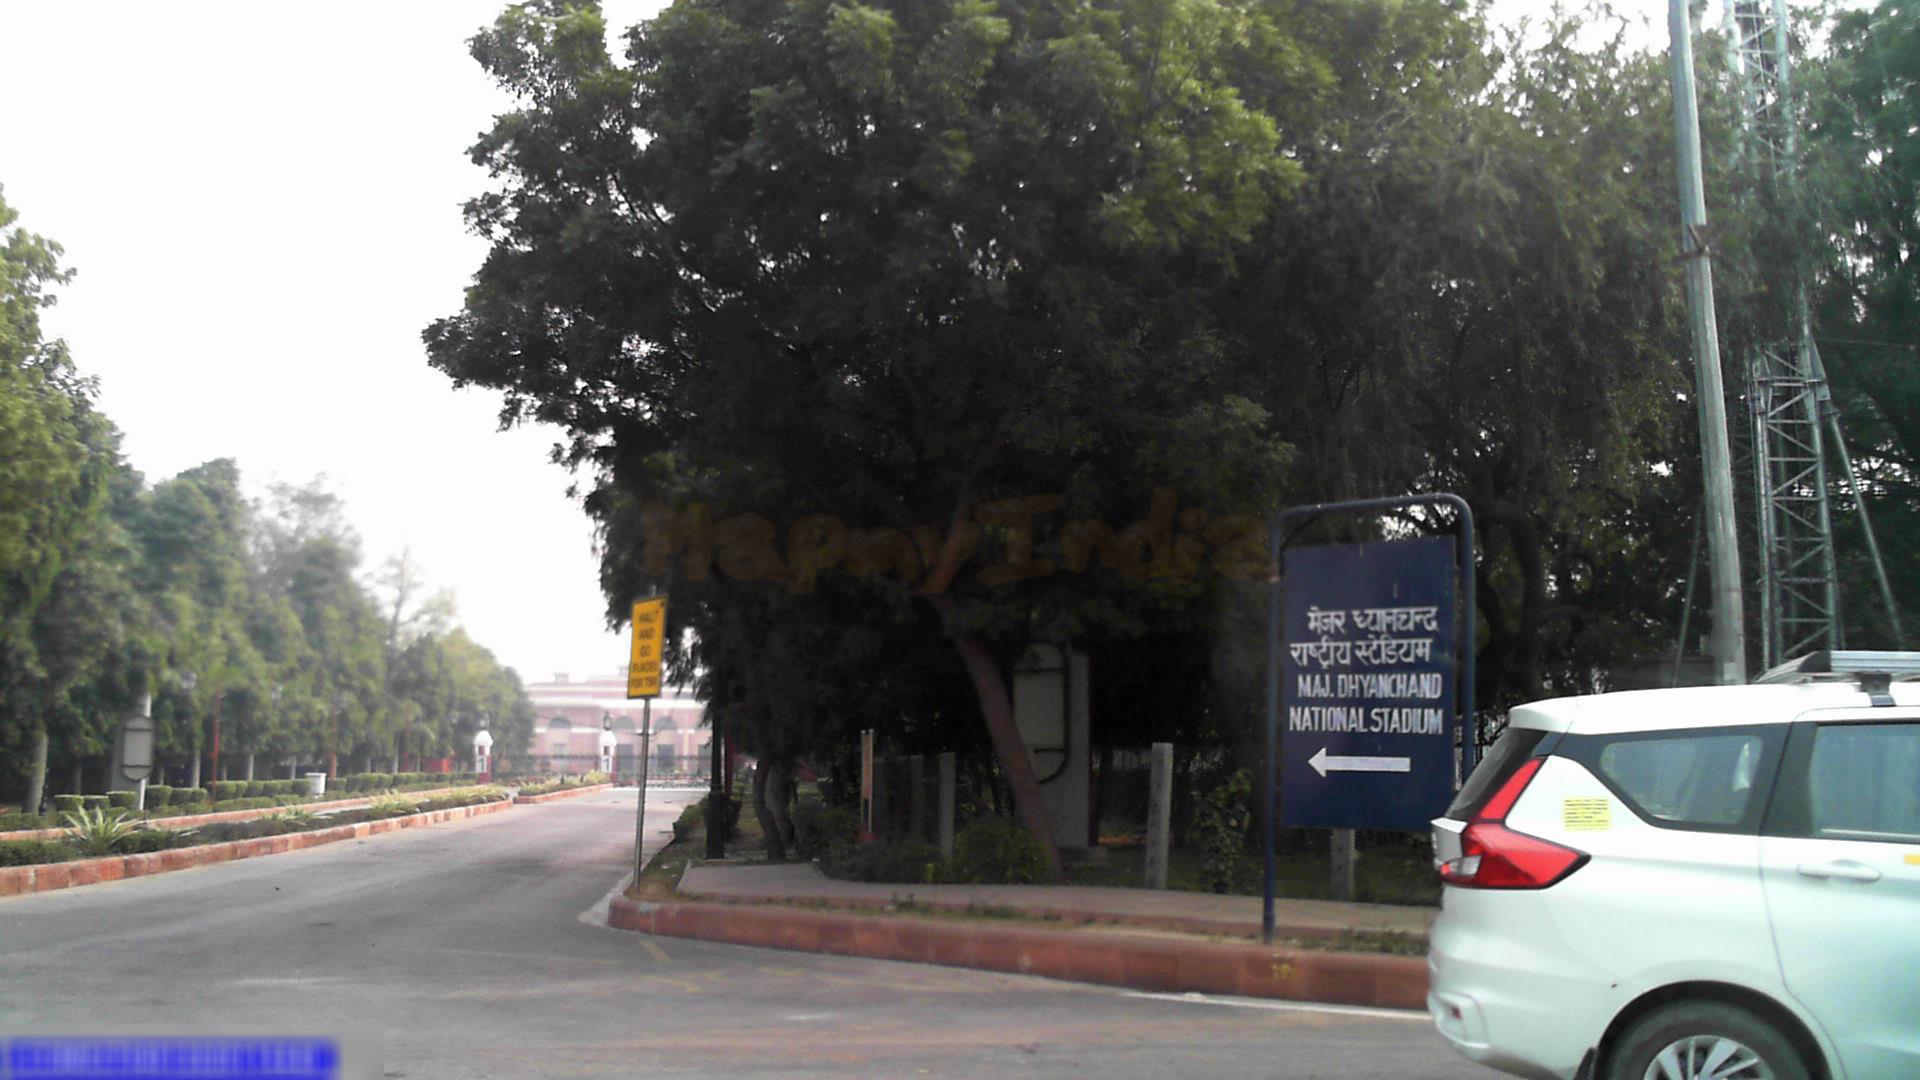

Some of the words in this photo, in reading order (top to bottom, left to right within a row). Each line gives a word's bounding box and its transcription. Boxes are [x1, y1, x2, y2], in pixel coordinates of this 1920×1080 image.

[1298, 674, 1334, 698] MAJ.
[1338, 674, 1442, 699] DHYANCHAND
[1289, 706, 1367, 733] NATIONAL
[1370, 707, 1443, 734] STADIUM
